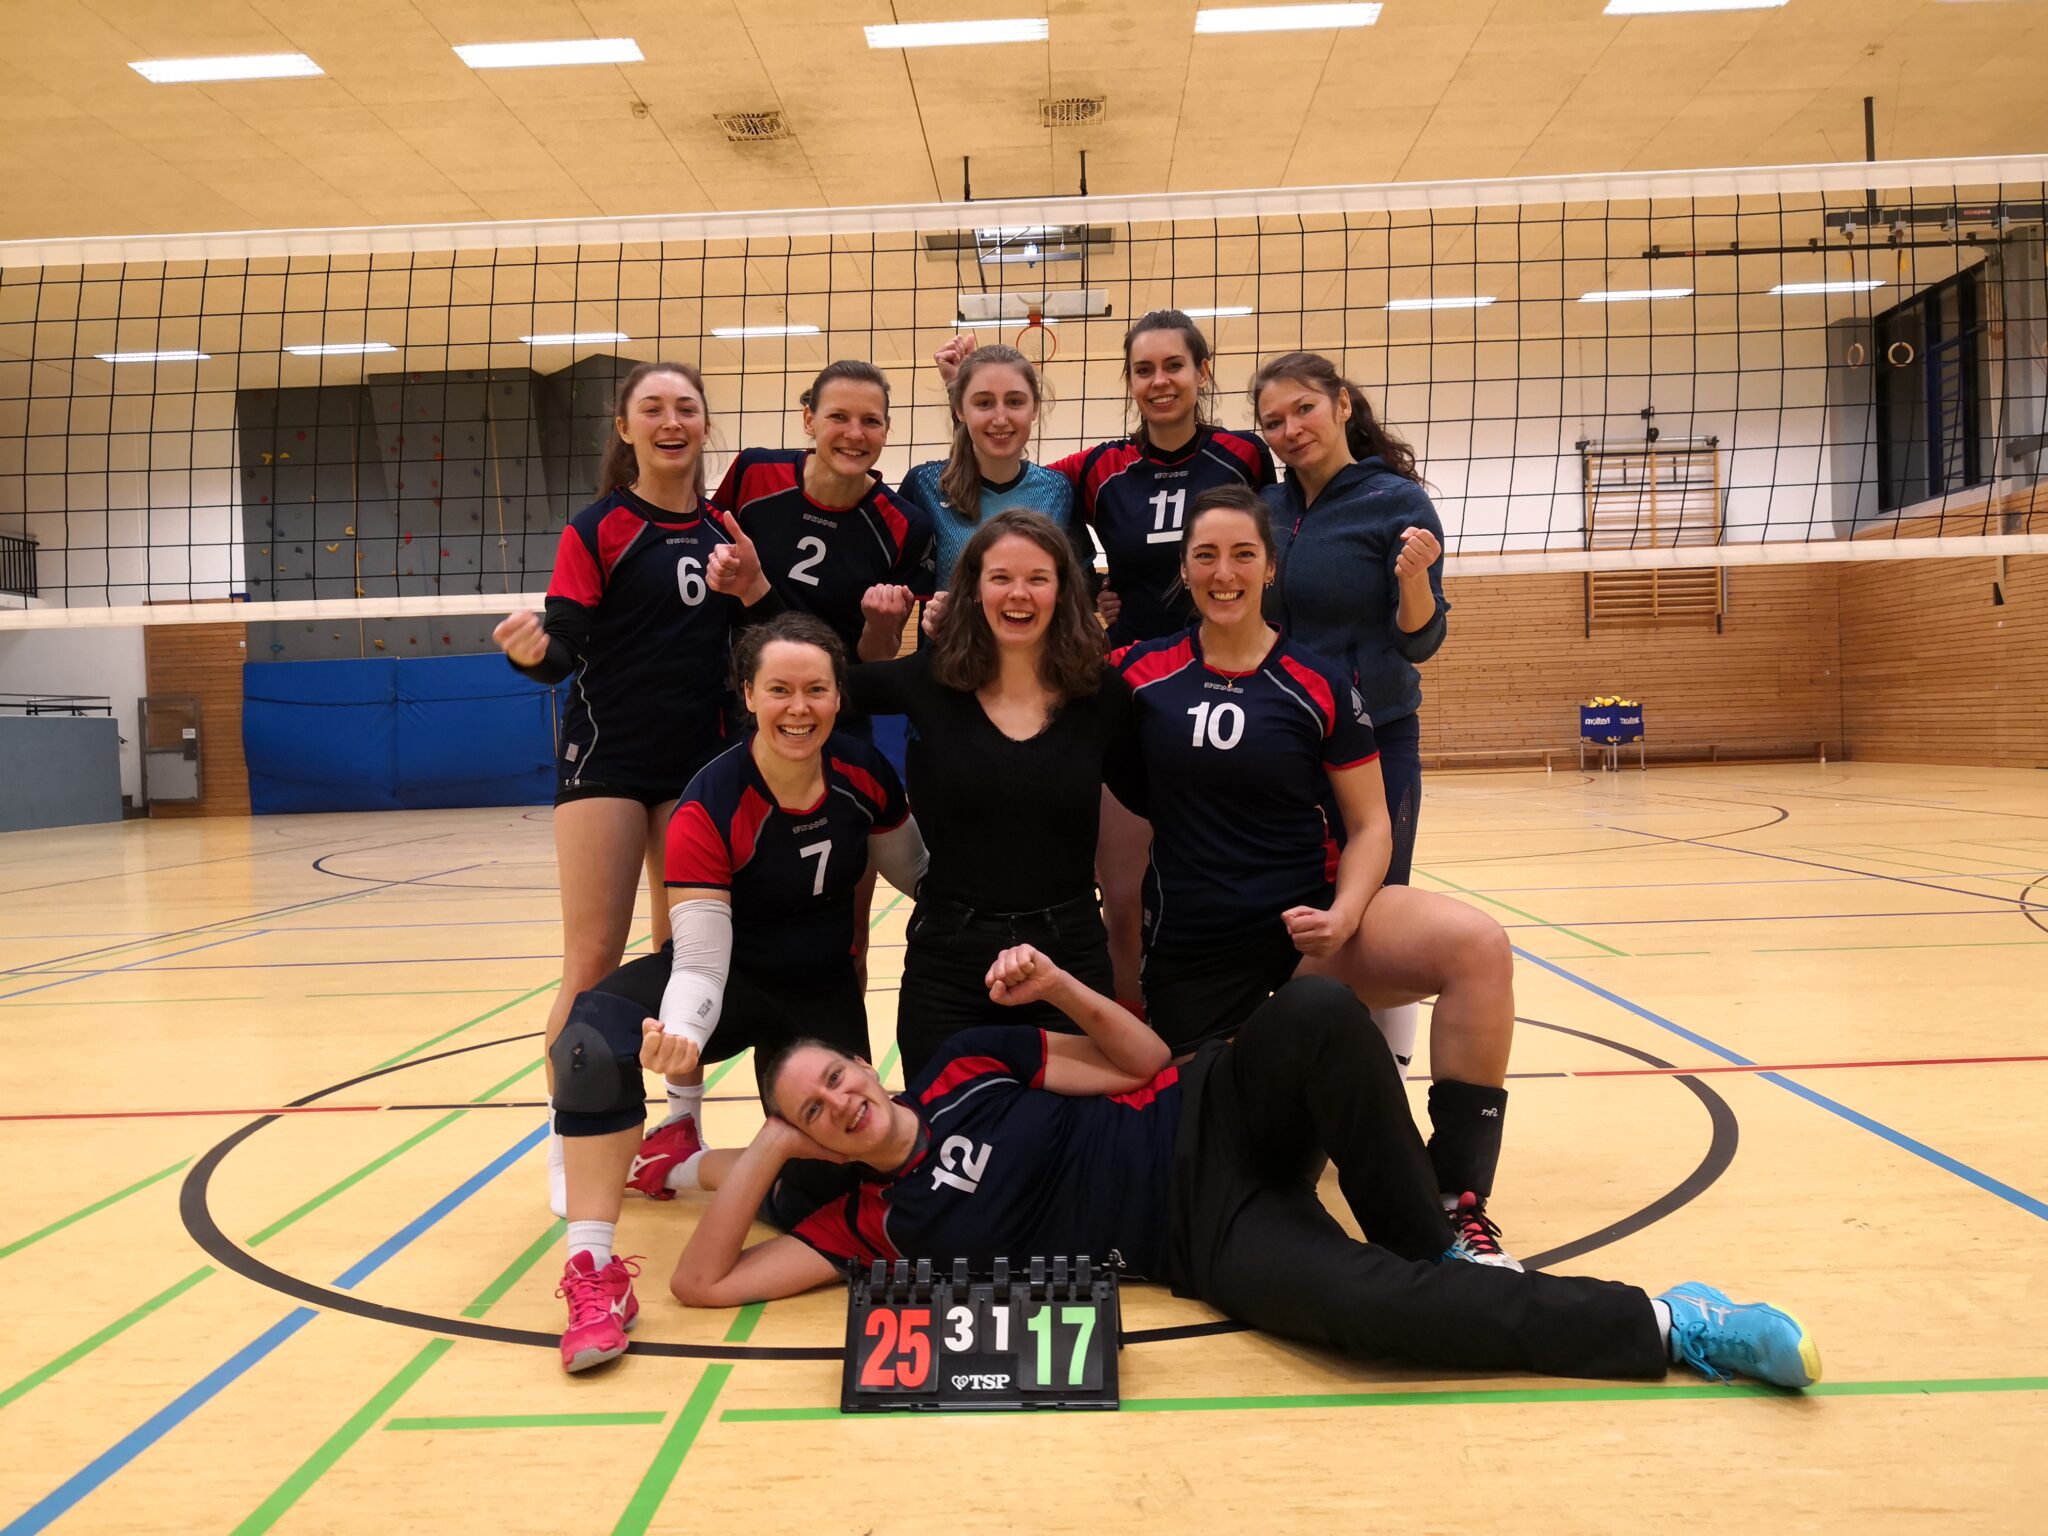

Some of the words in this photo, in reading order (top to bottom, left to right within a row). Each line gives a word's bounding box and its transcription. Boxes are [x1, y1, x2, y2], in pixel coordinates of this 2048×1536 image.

[1148, 489, 1187, 530] 11
[677, 556, 707, 606] 6
[787, 536, 828, 587] 2
[1187, 701, 1246, 750] 10
[1585, 717, 1610, 725] molten
[799, 839, 833, 896] 7
[930, 1135, 993, 1194] 12
[860, 1308, 931, 1388] 25
[944, 1306, 974, 1352] 3
[992, 1306, 1009, 1351] 1
[1027, 1305, 1096, 1385] 17
[969, 1374, 1010, 1390] TSP
